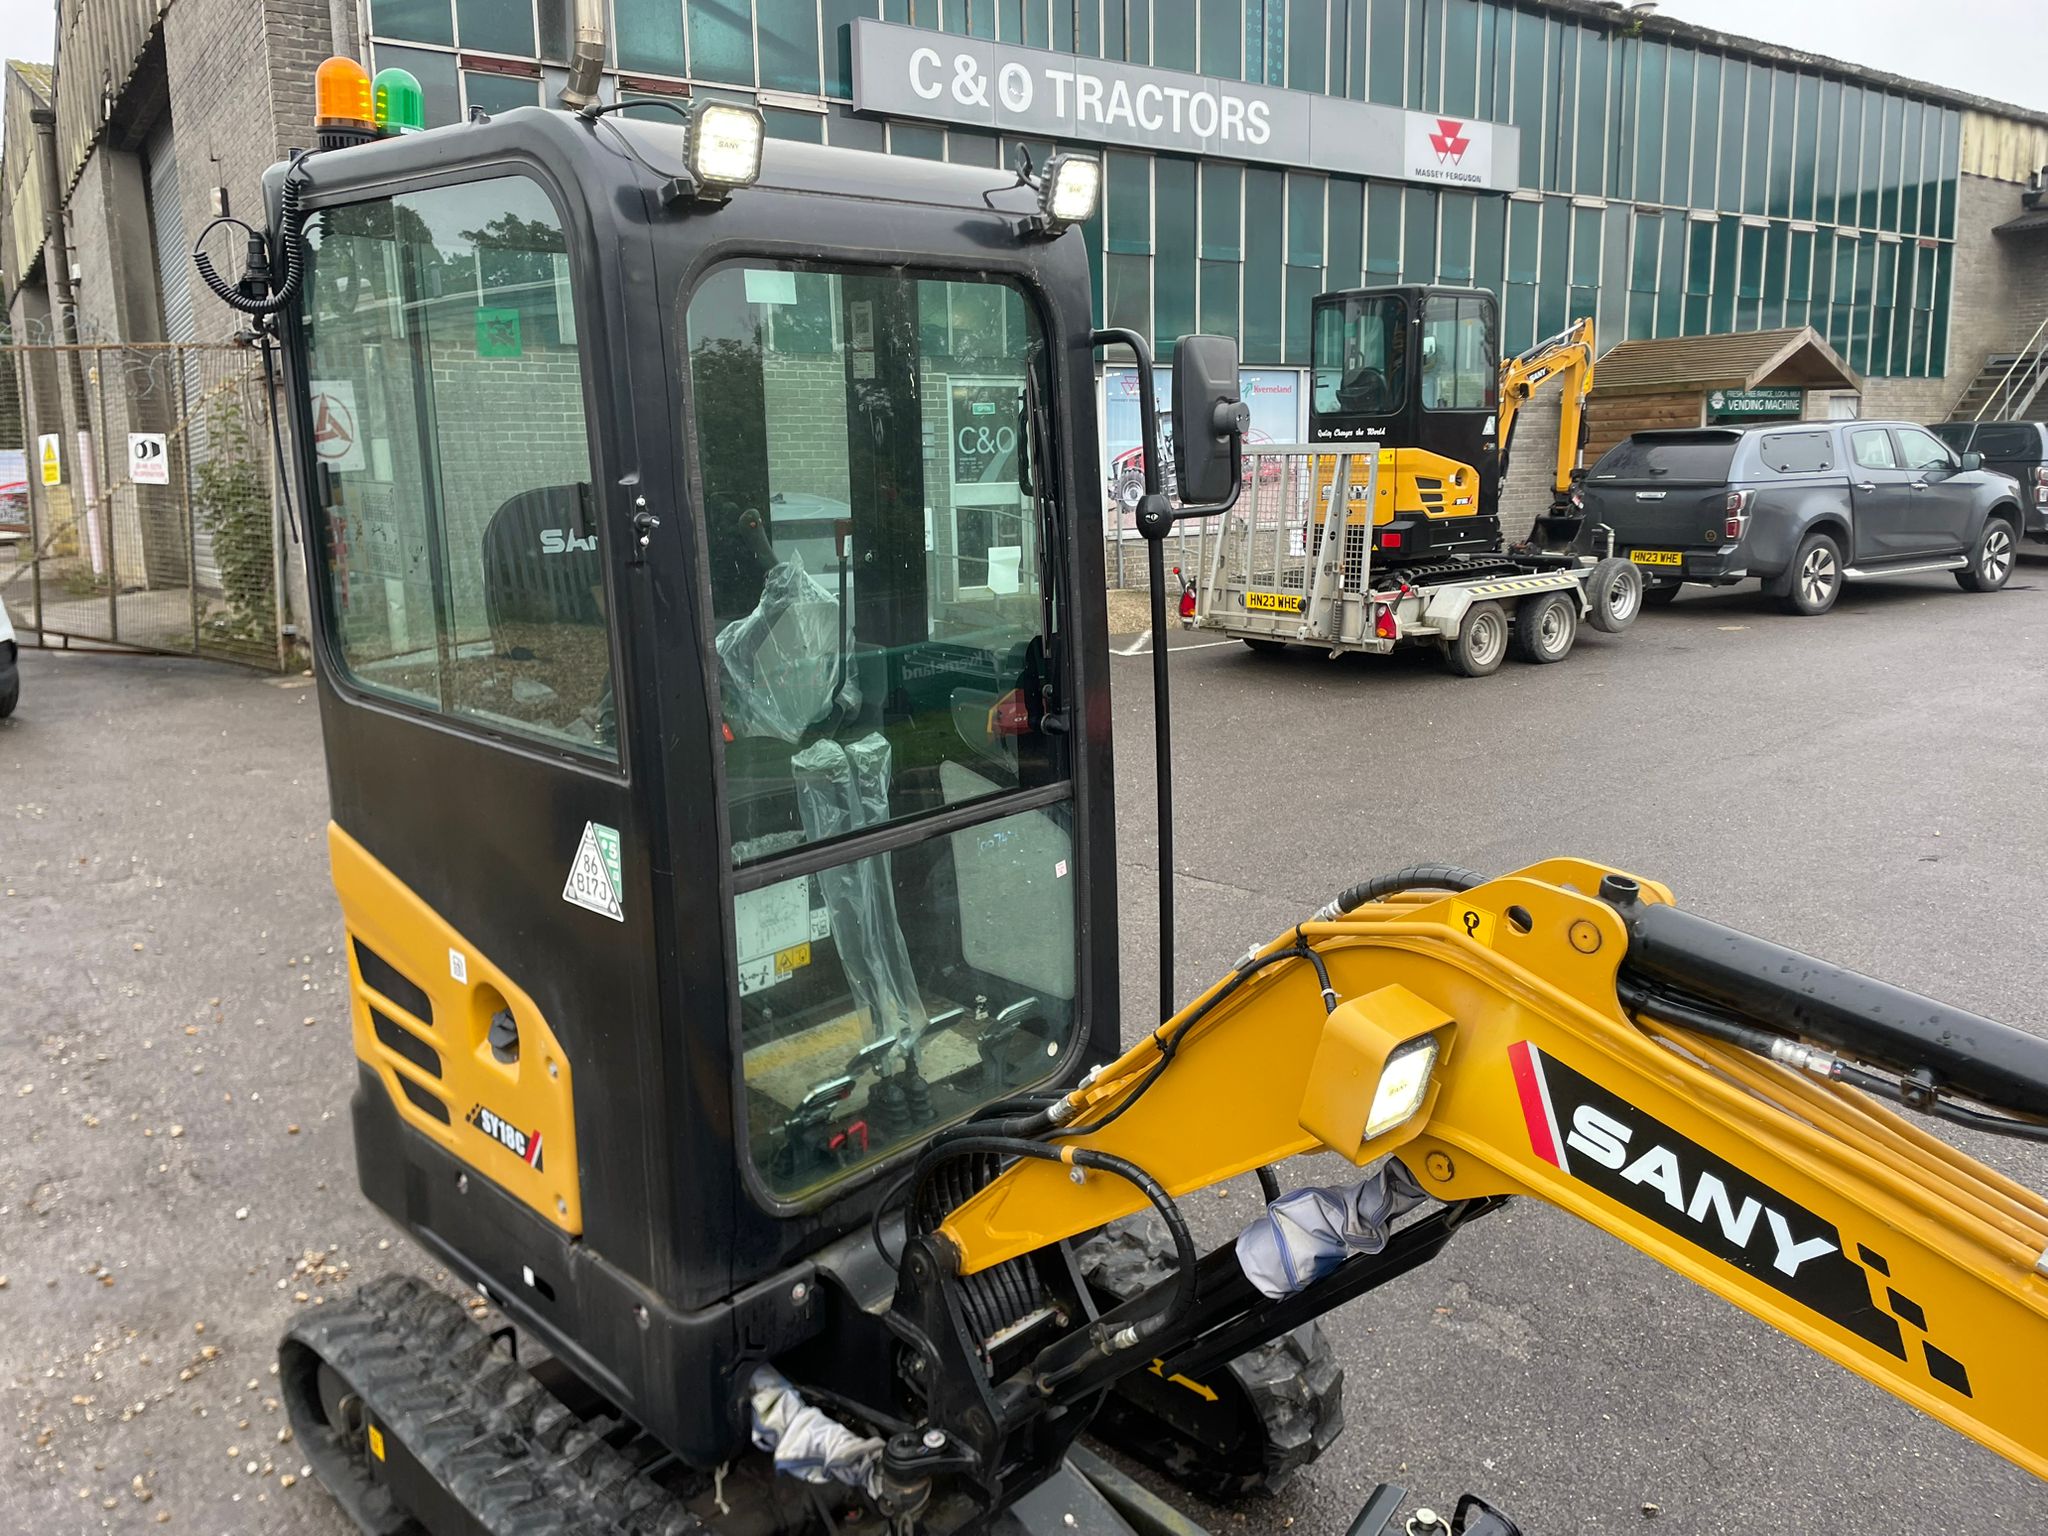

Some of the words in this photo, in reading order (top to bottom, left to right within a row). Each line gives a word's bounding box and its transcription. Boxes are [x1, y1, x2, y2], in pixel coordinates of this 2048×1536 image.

[1045, 68, 1271, 145] TRACTORS
[1415, 168, 1444, 179] MASSEY
[1446, 171, 1482, 184] FERGUSON
[1253, 384, 1292, 393] Kverneland
[1728, 399, 1764, 411] VENDING
[1765, 399, 1800, 411] MACHINE
[1366, 426, 1386, 436] World
[958, 426, 1015, 454] C&O
[1633, 551, 1658, 563] HN23
[1660, 552, 1678, 564] WHE
[1250, 593, 1275, 608] HN23
[1278, 595, 1298, 610] WHE
[583, 854, 598, 876] 86
[481, 1108, 526, 1157] SY18C
[1566, 1104, 1839, 1278] SANY
